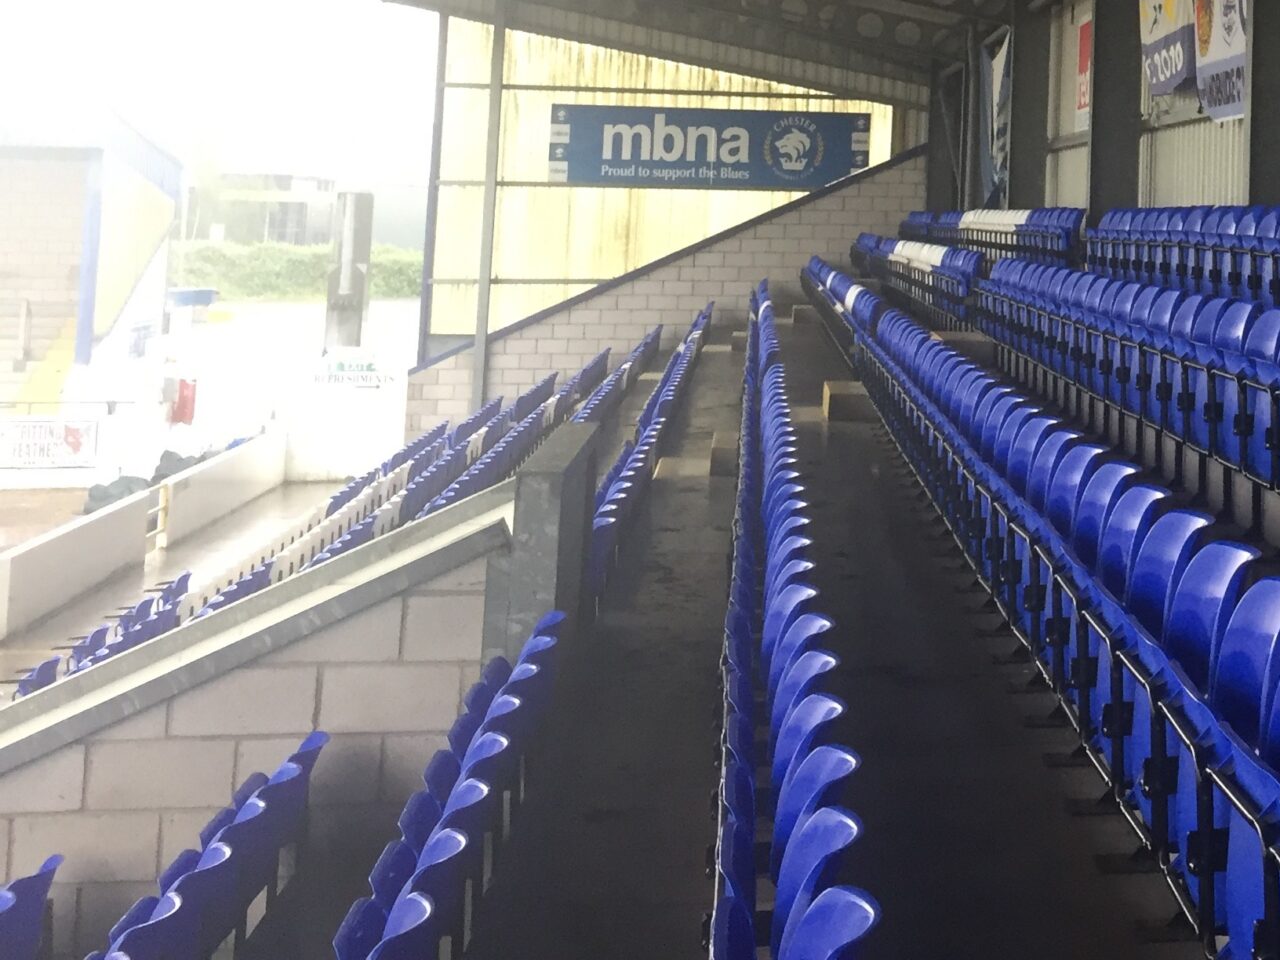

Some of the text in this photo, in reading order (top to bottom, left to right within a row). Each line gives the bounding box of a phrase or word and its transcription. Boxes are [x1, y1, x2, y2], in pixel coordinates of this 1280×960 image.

[773, 115, 817, 133] CHESTER
[602, 113, 750, 164] mbna
[601, 164, 750, 181] Proud to support the Blues
